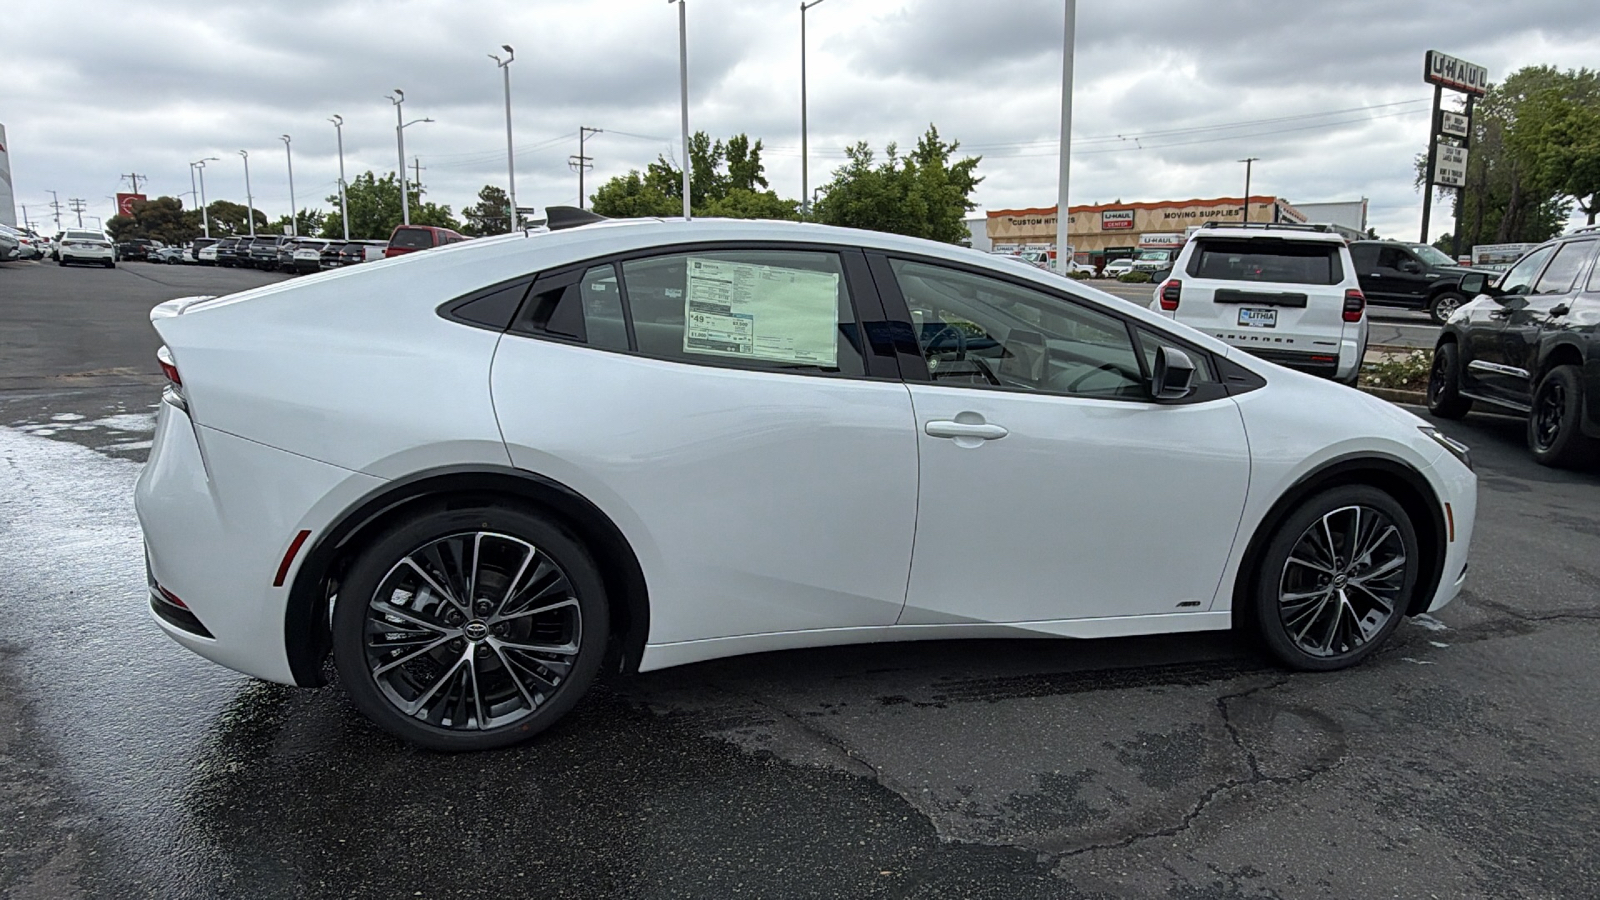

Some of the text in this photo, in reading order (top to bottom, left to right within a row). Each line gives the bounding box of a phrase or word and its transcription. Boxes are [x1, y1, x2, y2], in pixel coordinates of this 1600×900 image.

[1164, 209, 1239, 219] MOVING SUPPLIES
[1012, 217, 1076, 226] CUSTOM HITES
[1248, 312, 1274, 320] LITHIA
